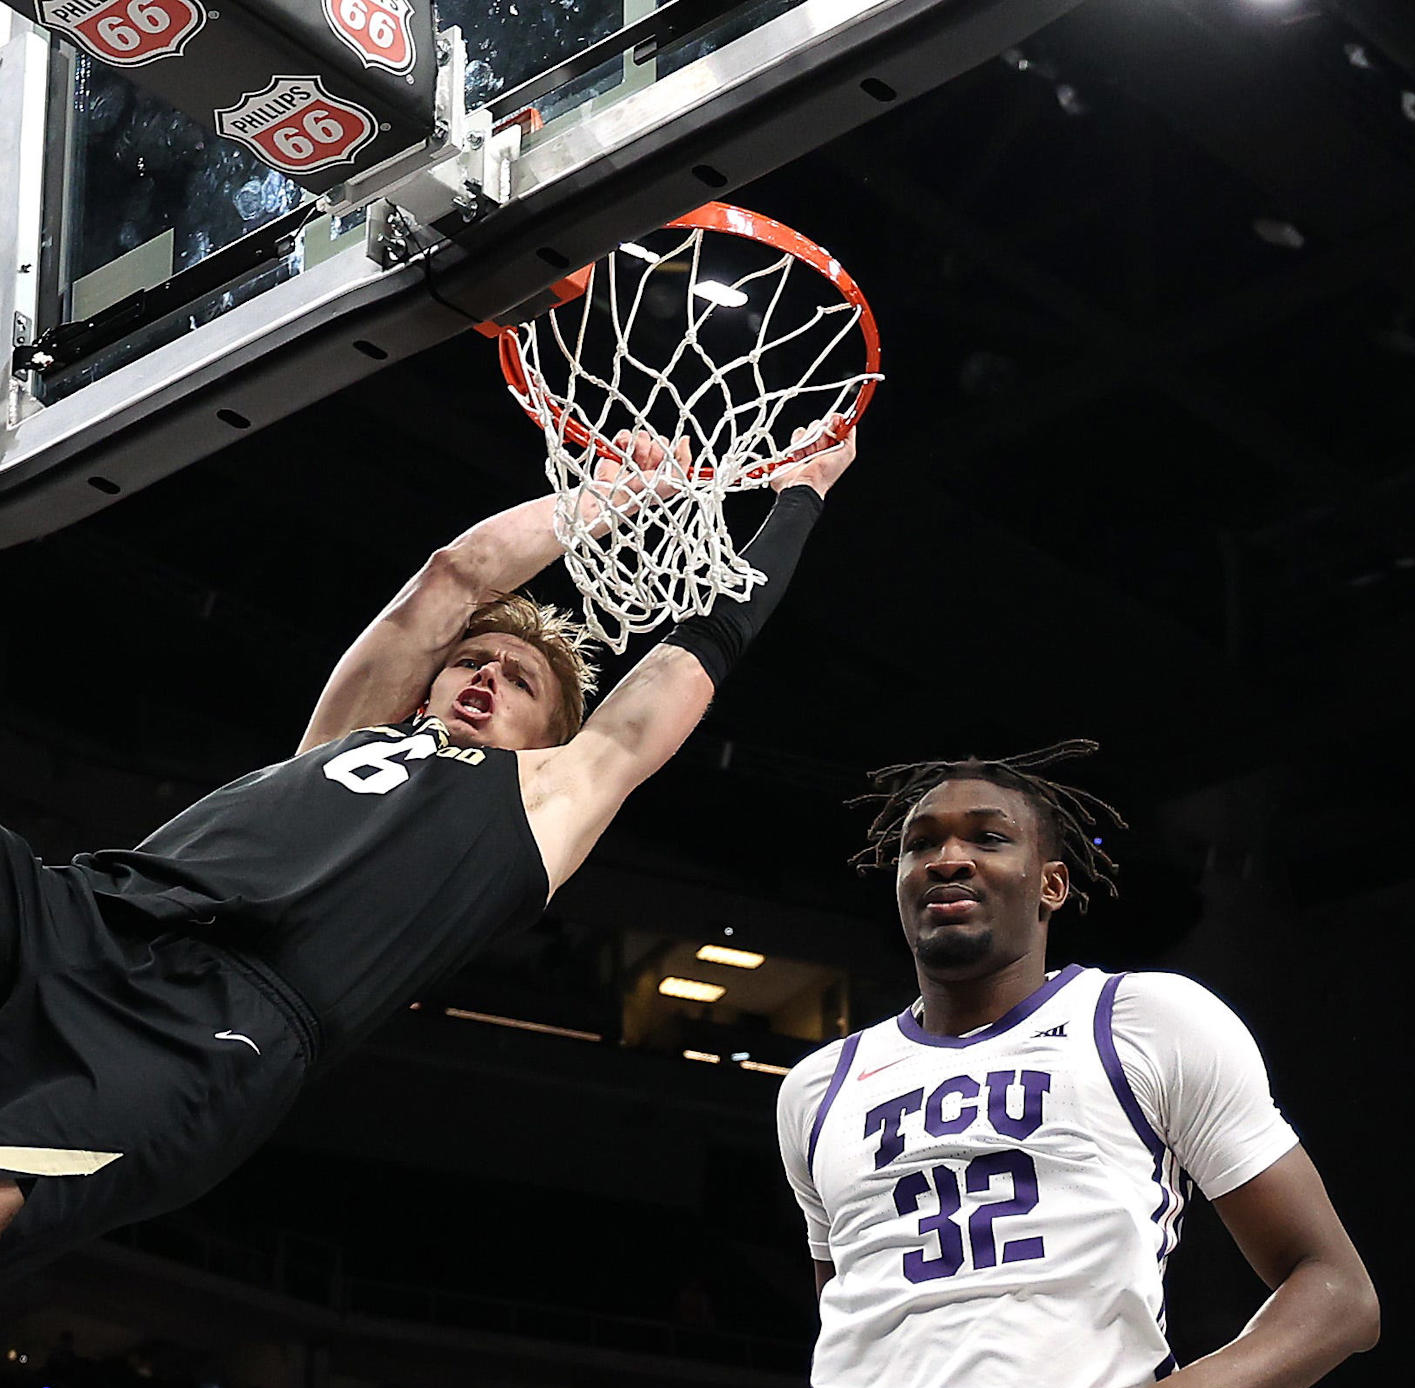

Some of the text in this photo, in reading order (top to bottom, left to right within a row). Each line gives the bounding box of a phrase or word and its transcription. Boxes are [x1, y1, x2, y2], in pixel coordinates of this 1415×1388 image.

[96, 0, 171, 51] 66
[340, 0, 398, 49] 66
[235, 86, 312, 134] PHILLIPS
[271, 109, 345, 159] 66
[322, 733, 437, 794] 6
[863, 1069, 1051, 1171] TCU
[893, 1149, 1045, 1285] 32
